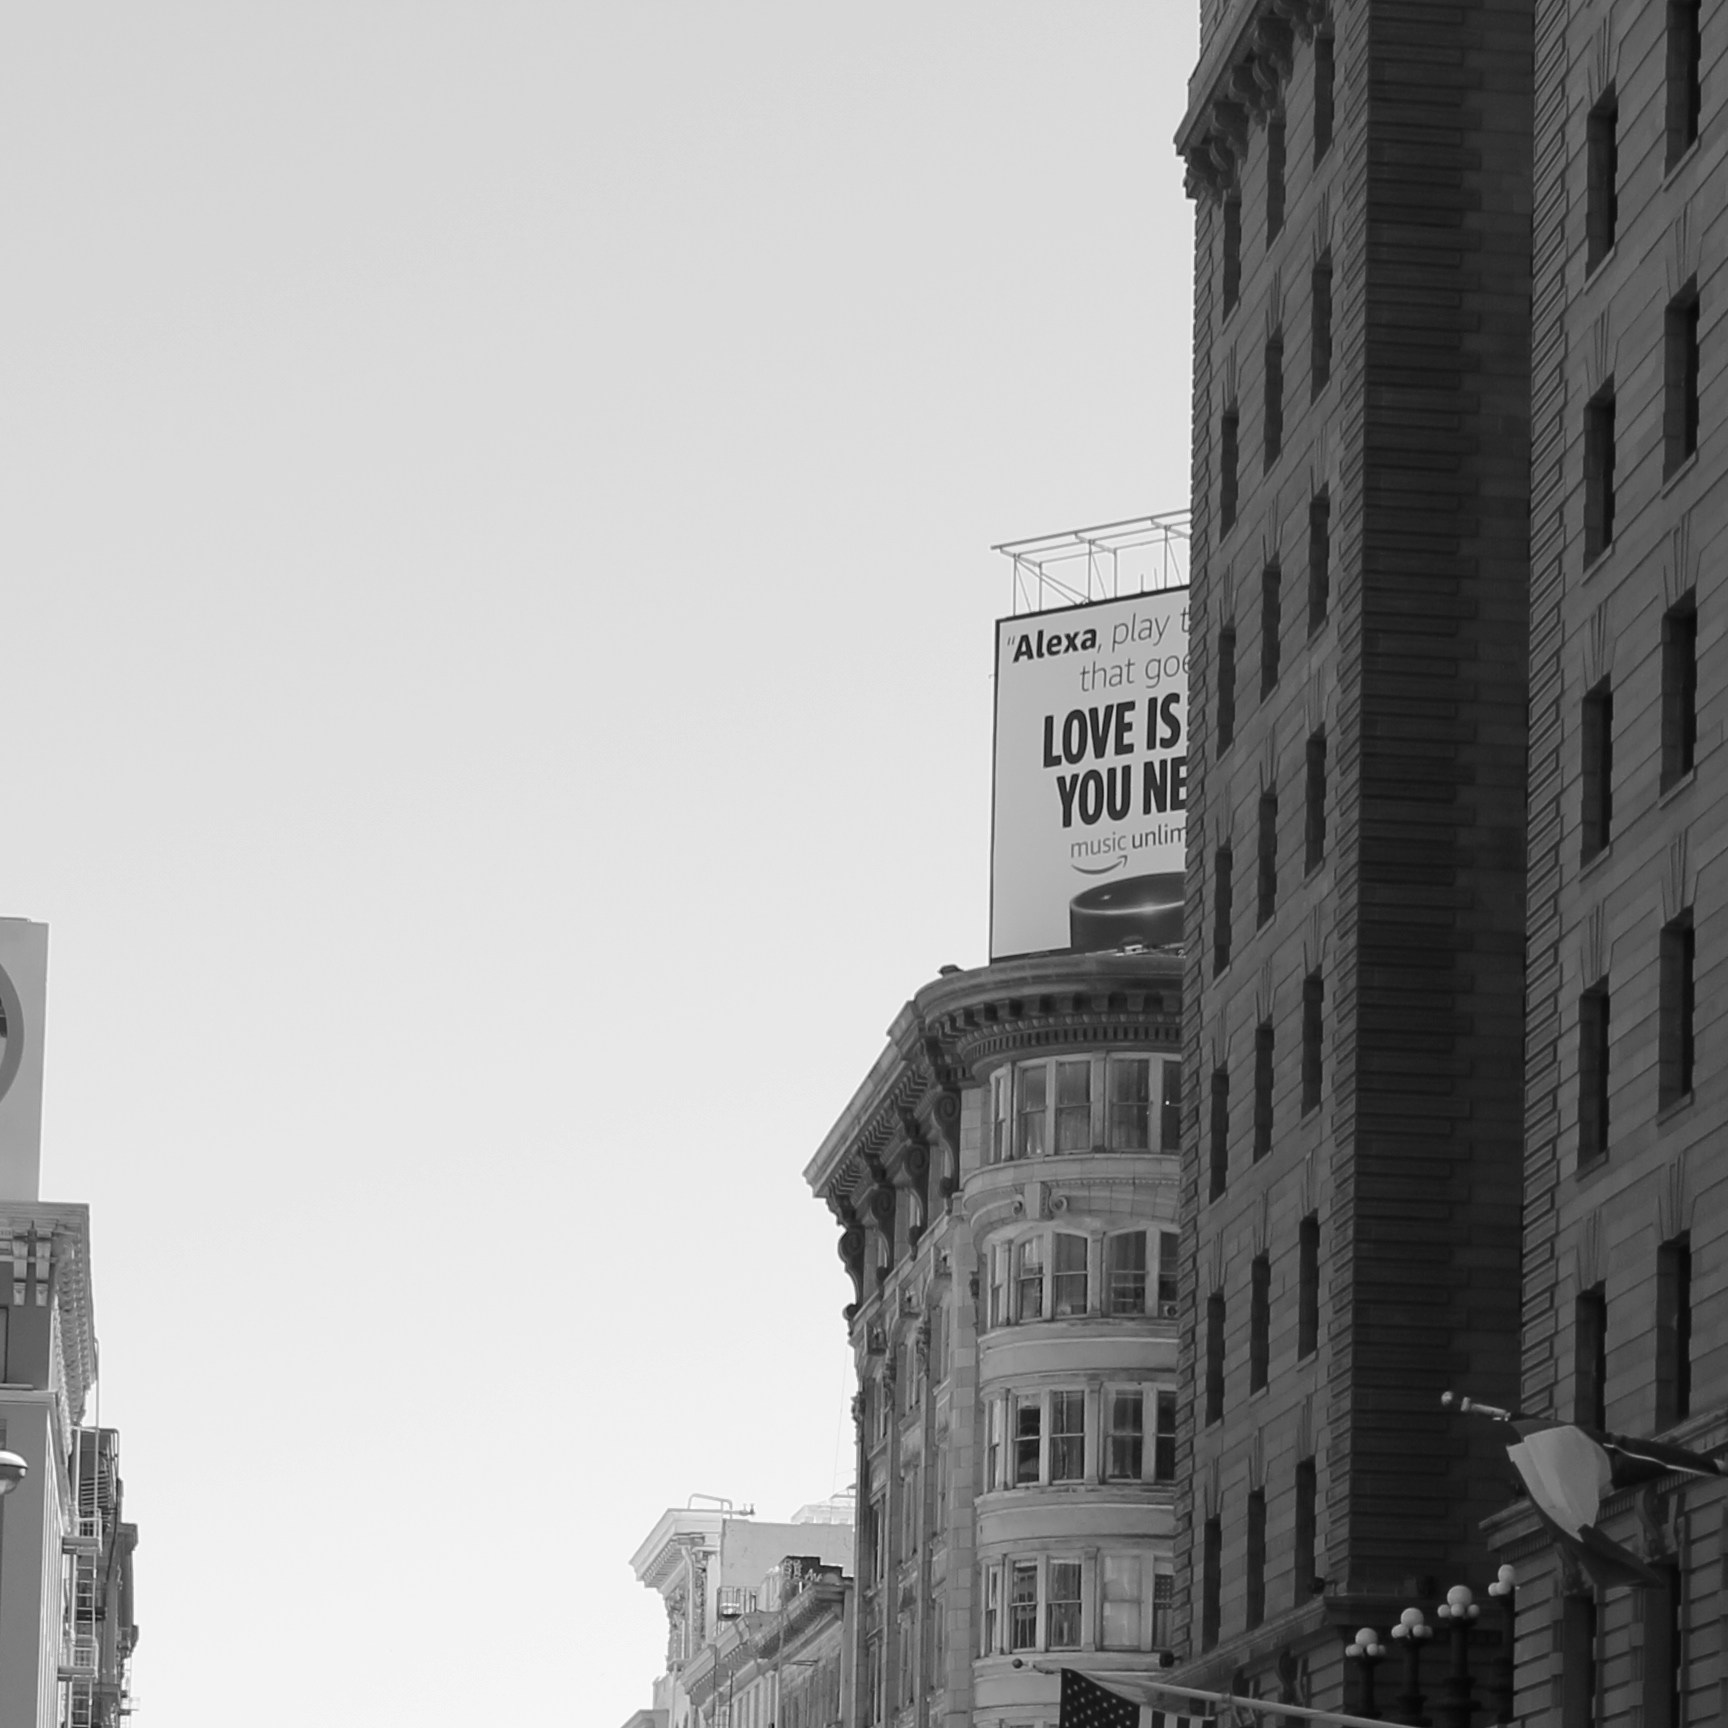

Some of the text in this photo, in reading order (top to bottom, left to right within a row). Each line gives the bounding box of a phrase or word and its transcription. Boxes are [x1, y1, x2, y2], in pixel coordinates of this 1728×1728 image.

[1113, 613, 1170, 653] play
[1080, 659, 1136, 692] that
[1043, 692, 1181, 768] LOVE IS
[1057, 764, 1132, 828] YOU
[1071, 831, 1127, 858] music
